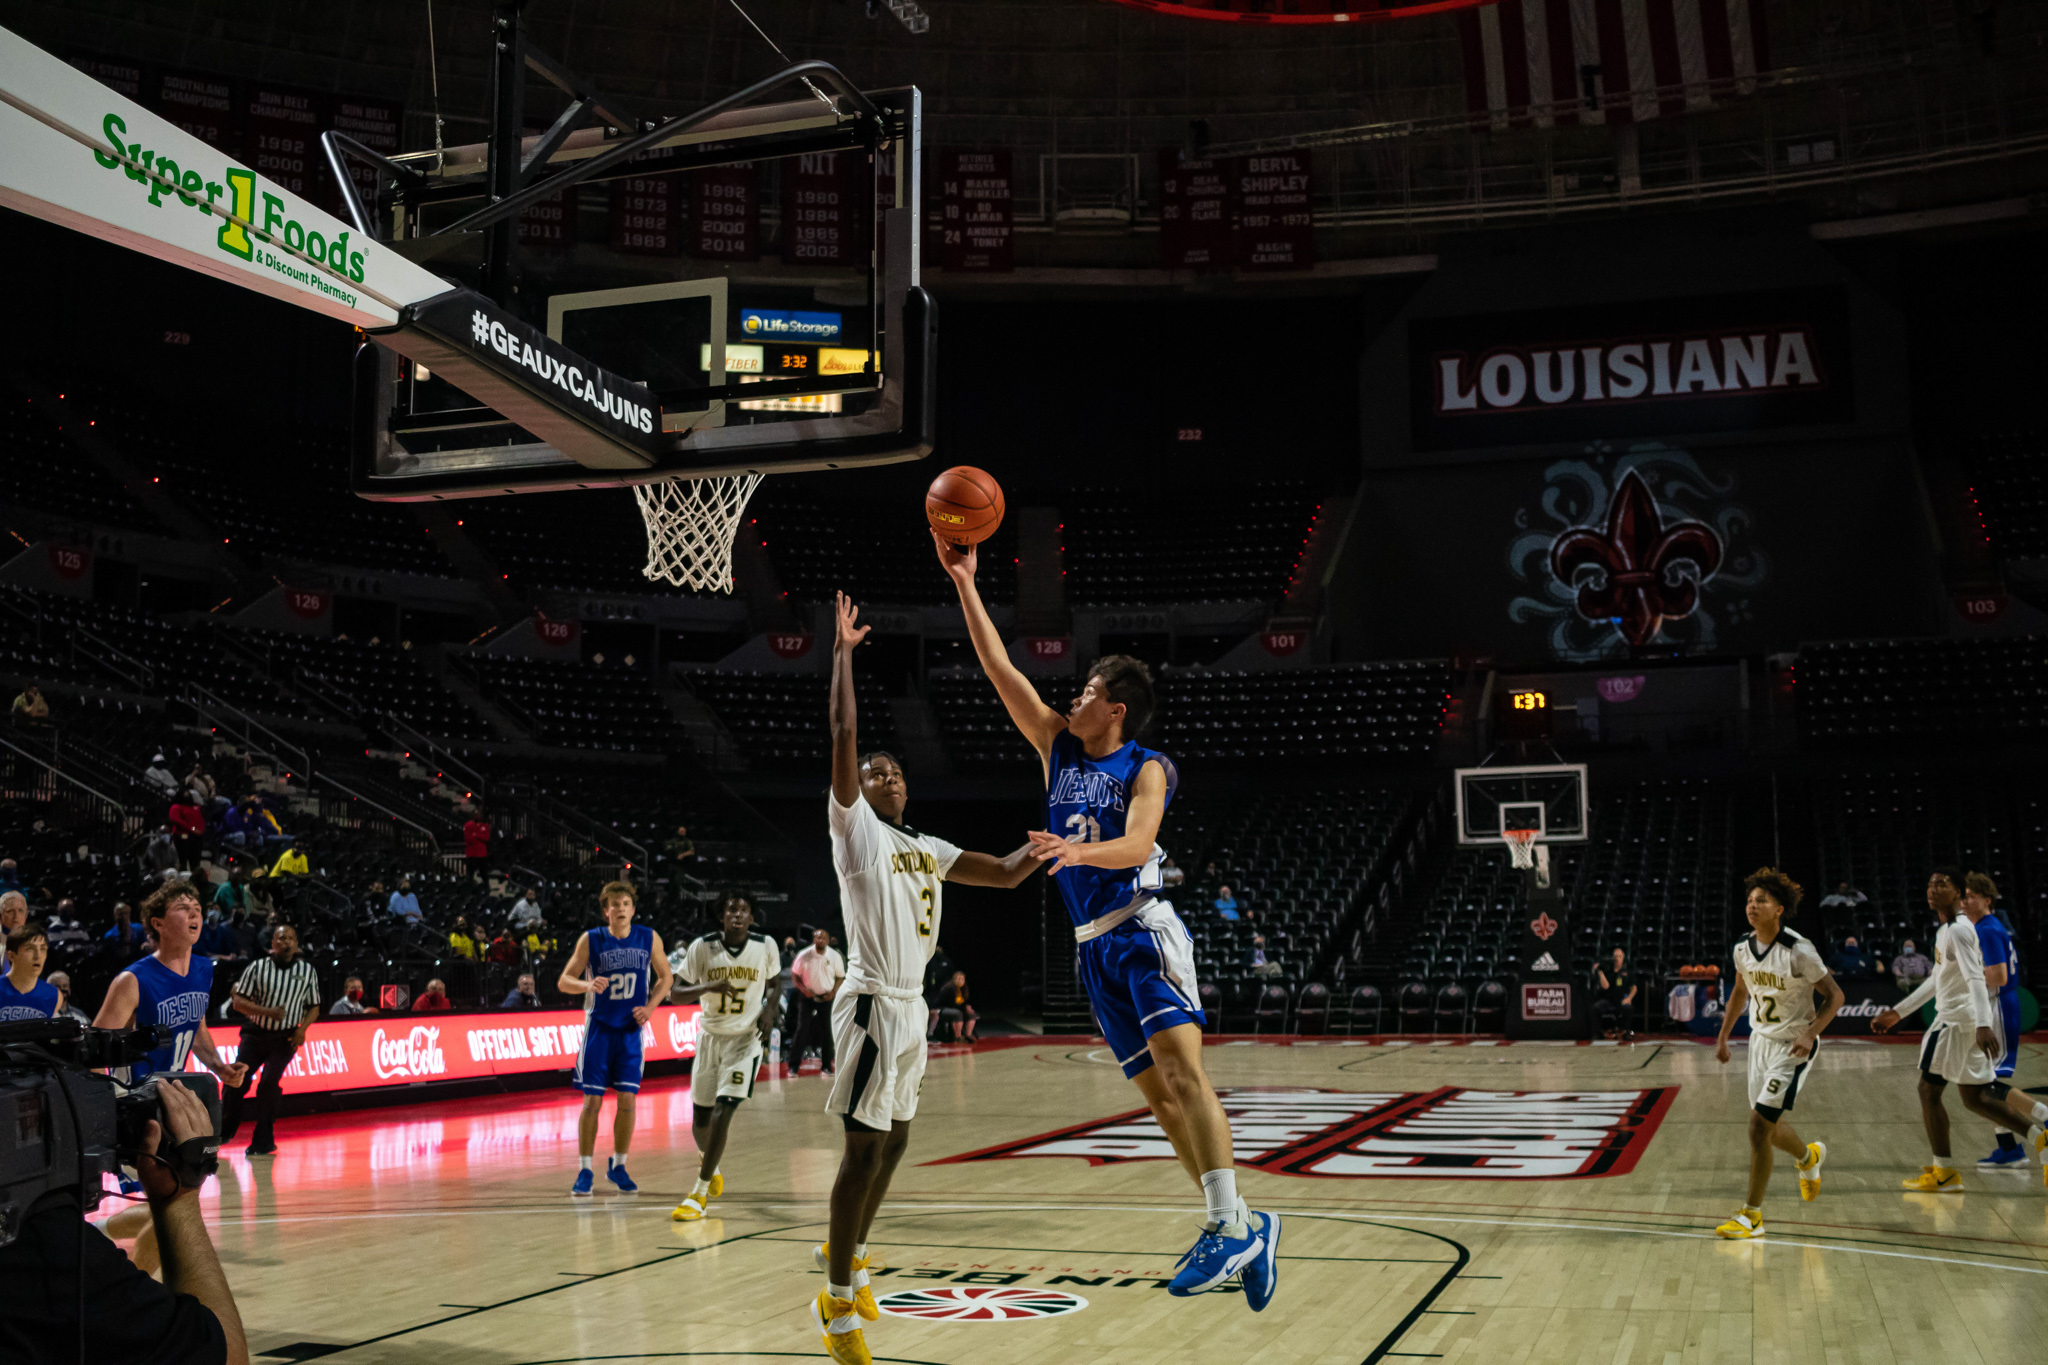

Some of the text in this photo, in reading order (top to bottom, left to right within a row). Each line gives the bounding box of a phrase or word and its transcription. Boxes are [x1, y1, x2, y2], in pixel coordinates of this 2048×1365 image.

[162, 88, 230, 111] CHAMPIONS
[284, 95, 310, 110] BELT
[258, 135, 305, 154] 1992
[258, 155, 304, 173] 2000
[800, 153, 838, 176] NIT
[1248, 156, 1302, 174] BERYL
[625, 179, 668, 195] 1972
[703, 184, 747, 199] 1992
[944, 181, 958, 195] 14
[1240, 175, 1309, 193] SHIPLEY
[94, 113, 365, 284] Super 1 Foods
[625, 196, 667, 212] 1973
[797, 191, 840, 206] 1980
[1244, 194, 1308, 206] HEAD COACH
[703, 202, 746, 216] 1994
[797, 209, 840, 223] 1984
[624, 214, 667, 230] 1982
[702, 220, 746, 235] 2000
[624, 233, 666, 249] 1983
[797, 226, 840, 241] 1985
[944, 230, 961, 244] 24
[702, 238, 746, 252] 2014
[796, 244, 840, 258] 2002
[256, 249, 358, 309] & Discount Pharmacy
[782, 354, 808, 369] 3:32
[472, 309, 653, 434] #GEAUXCAJUNS
[1439, 332, 1820, 411] LOUISIANA
[1178, 429, 1203, 441] 232
[58, 550, 81, 570] 125
[295, 594, 320, 610] 126
[1966, 599, 1996, 615] 103
[777, 637, 803, 650] 127
[1036, 640, 1062, 654] 128
[1271, 635, 1295, 648] 101
[1606, 678, 1635, 694] 102
[1514, 692, 1546, 711] 1:37
[918, 887, 933, 937] 3
[598, 947, 651, 974] JESUIT
[609, 972, 638, 1000] 20
[1537, 988, 1565, 998] FARM
[717, 988, 747, 1015] 15
[1527, 997, 1566, 1008] BUREAU
[1755, 994, 1781, 1023] 12
[169, 1030, 194, 1073] 11
[467, 1028, 532, 1062] OFFICIAL
[528, 1025, 562, 1058] SOFT
[304, 1039, 349, 1076] LHSAA
[371, 1026, 447, 1080] Coca-Cola
[732, 1071, 745, 1086] S
[1766, 1079, 1781, 1095] S
[1309, 1089, 1644, 1176] CAJUNS
